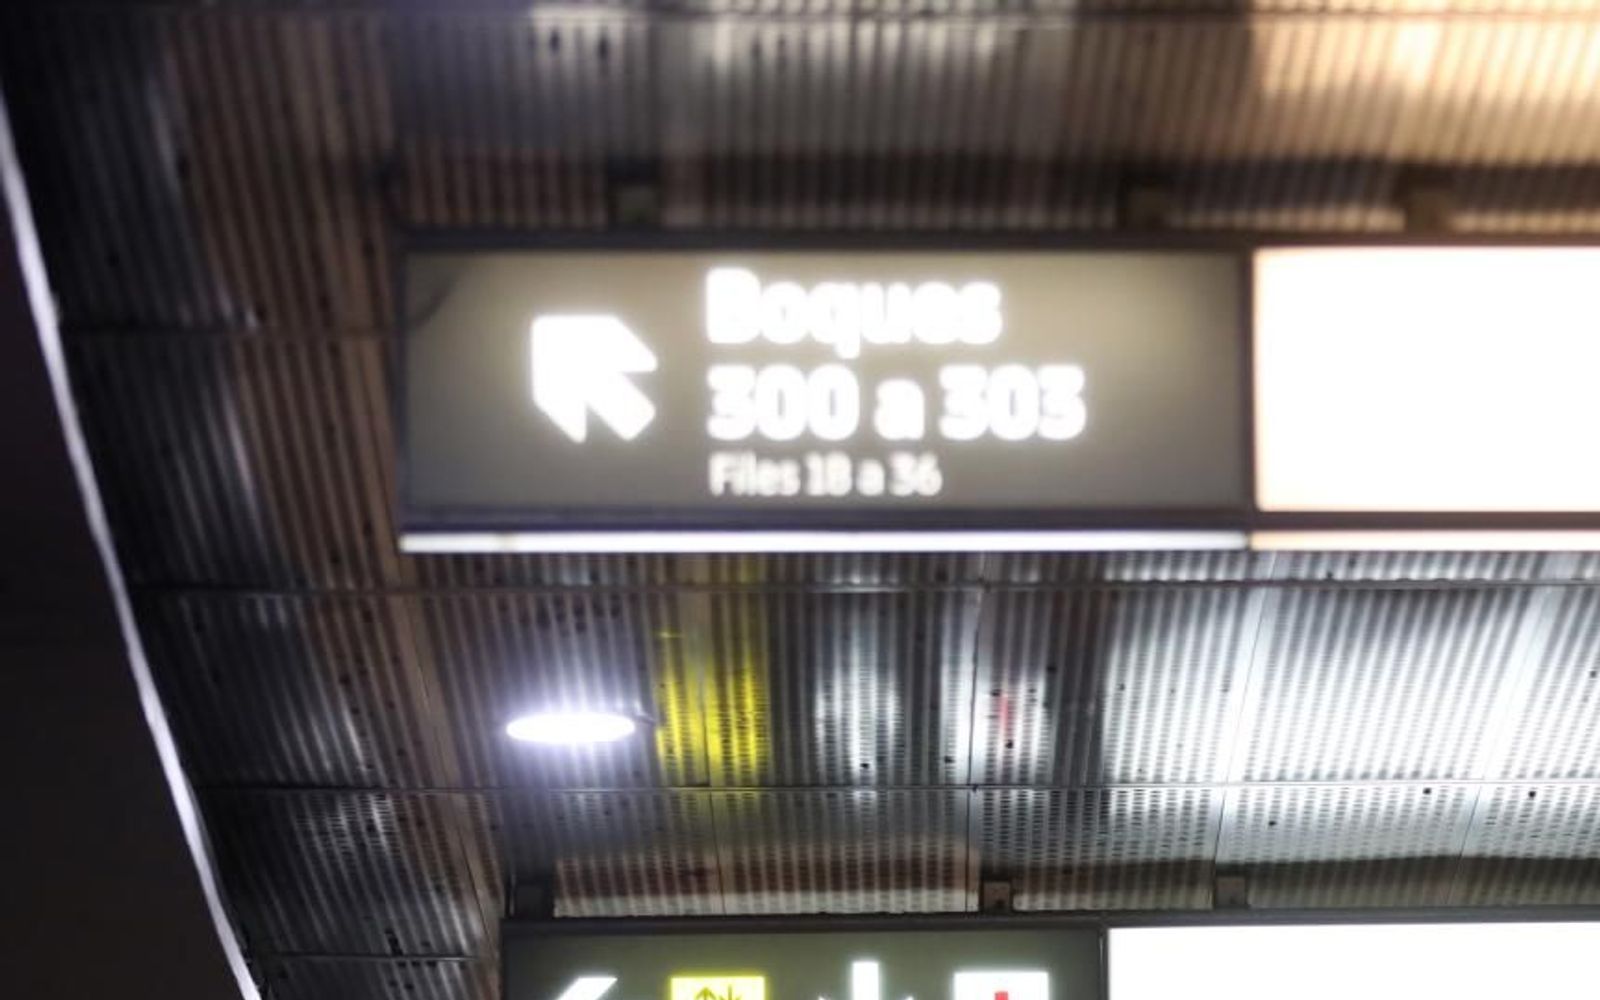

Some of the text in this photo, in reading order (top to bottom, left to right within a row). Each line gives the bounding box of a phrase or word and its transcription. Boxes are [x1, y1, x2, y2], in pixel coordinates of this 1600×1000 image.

[705, 267, 1004, 358] Boques
[707, 363, 1086, 441] 300 a 303
[709, 450, 801, 496] Files
[888, 450, 944, 496] 36
